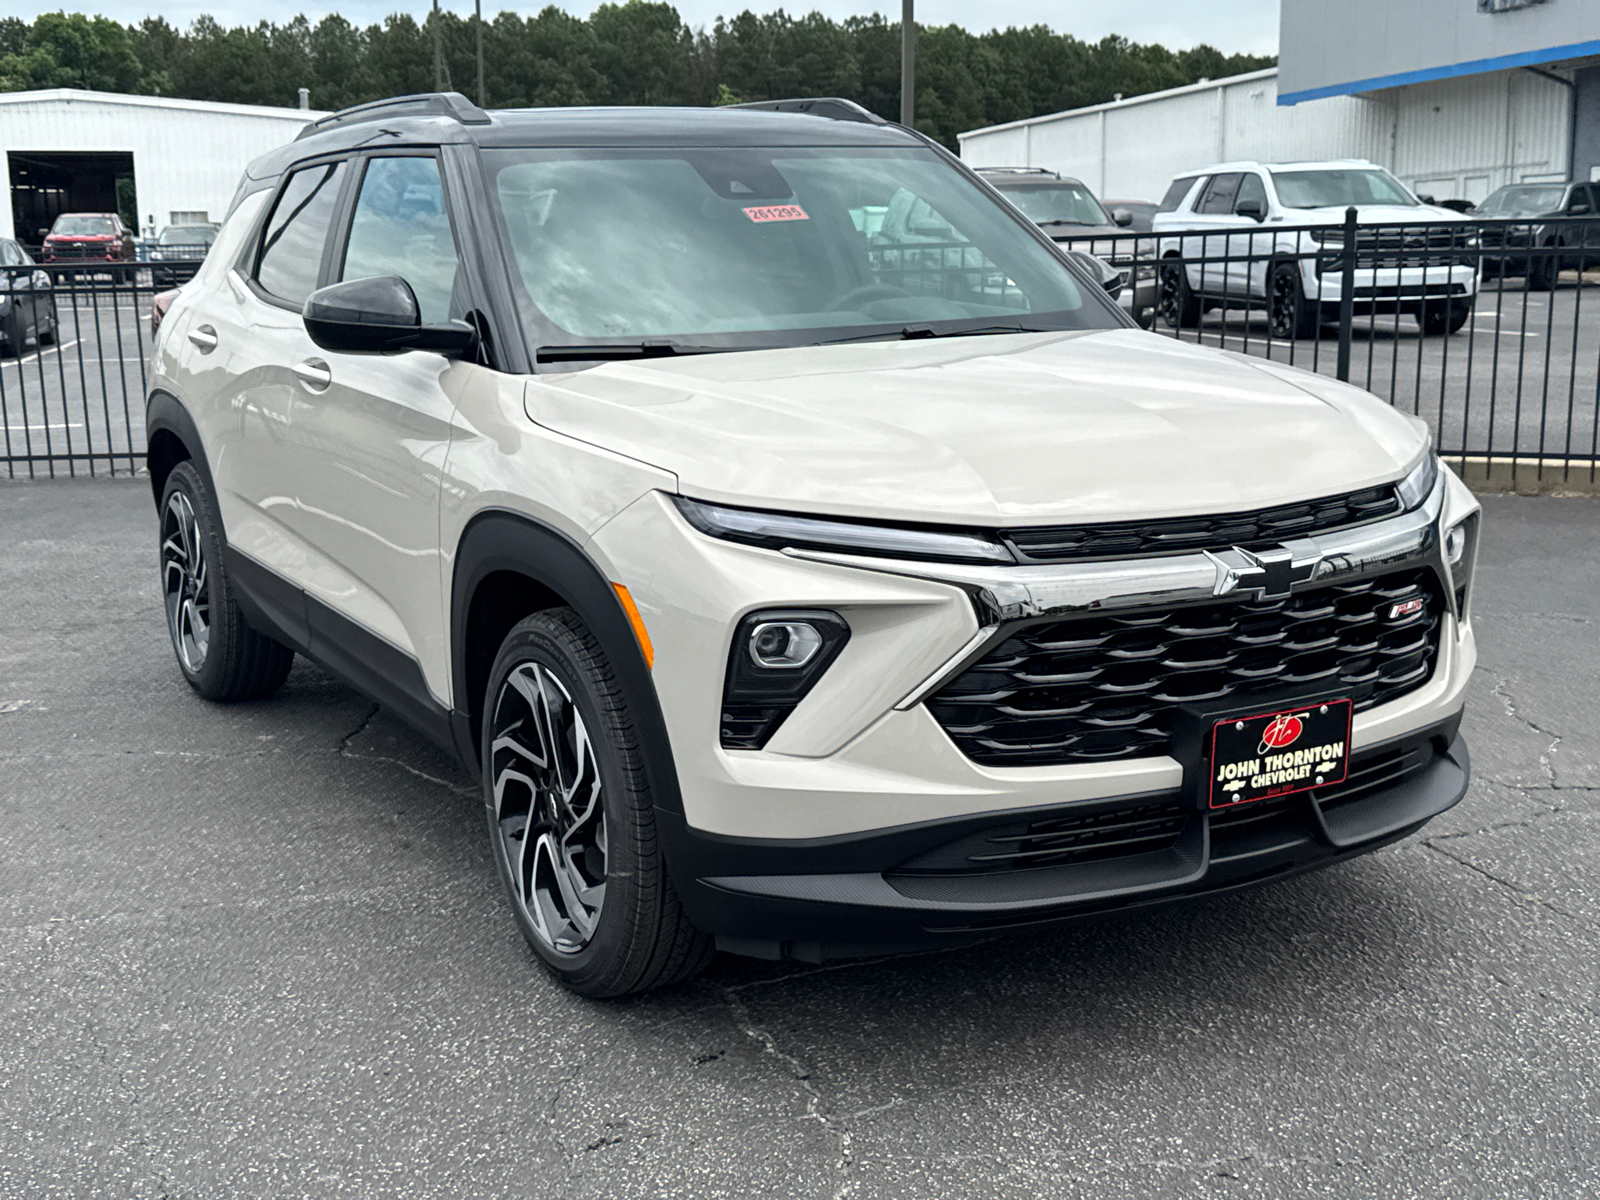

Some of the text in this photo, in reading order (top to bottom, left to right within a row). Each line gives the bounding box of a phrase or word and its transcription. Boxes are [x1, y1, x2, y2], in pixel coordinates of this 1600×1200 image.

[749, 206, 802, 220] 261295
[1390, 598, 1423, 618] RS
[1217, 742, 1343, 781] JOHN THORNTON
[1251, 765, 1311, 788] CHEVROLET
